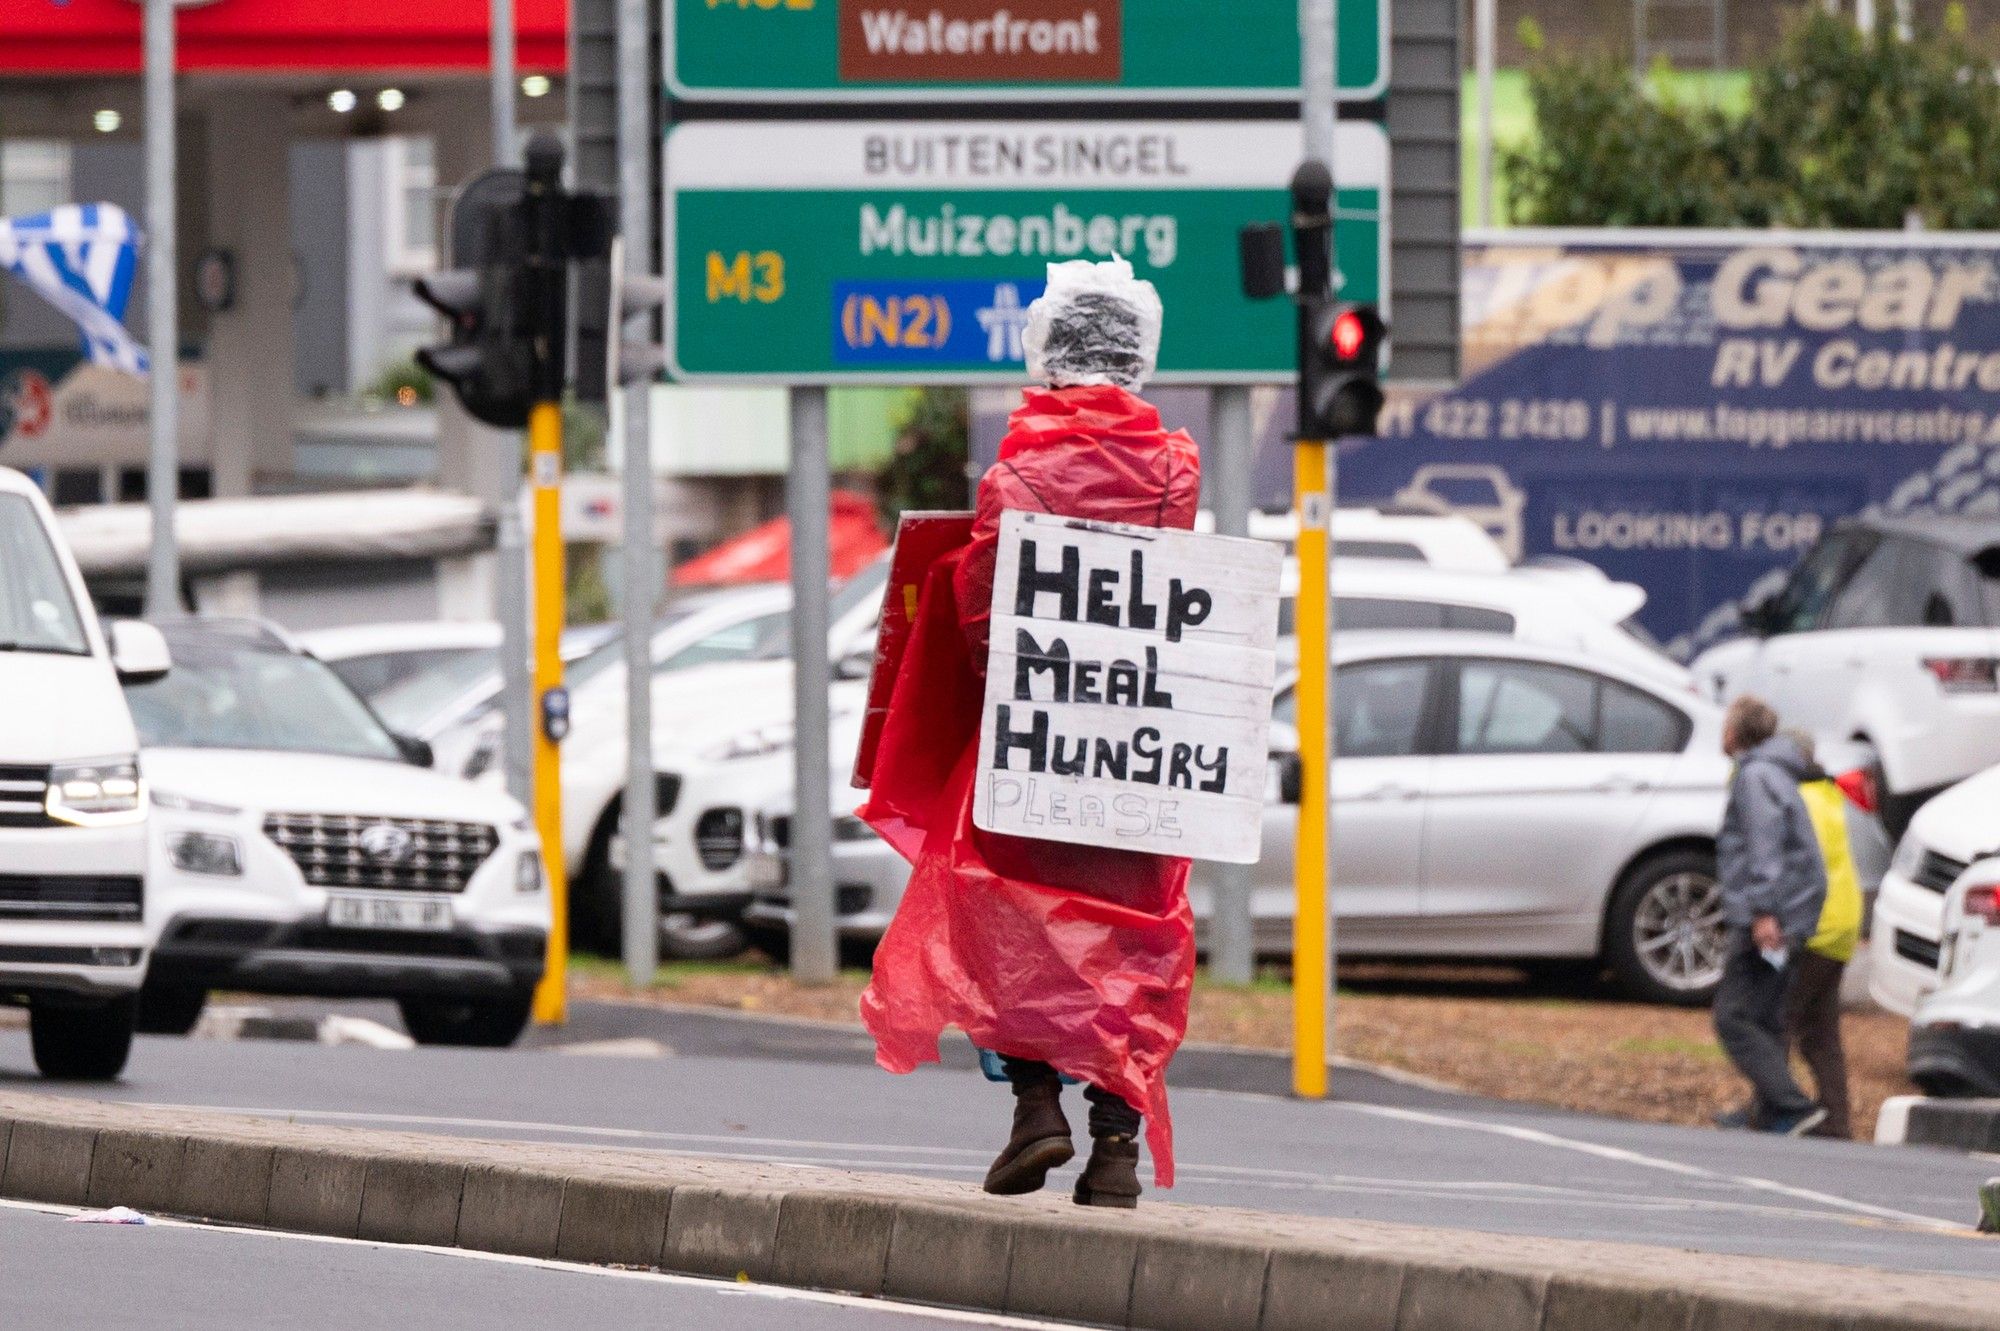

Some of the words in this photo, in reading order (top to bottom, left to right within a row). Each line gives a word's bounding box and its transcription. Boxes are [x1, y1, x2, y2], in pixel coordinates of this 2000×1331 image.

[862, 10, 1101, 56] Waterfront
[859, 201, 1178, 268] Muizenberg
[705, 251, 786, 304] M3
[1711, 246, 1986, 332] Gear
[841, 294, 952, 349] (N2)
[1711, 341, 1801, 389] RV
[1813, 340, 2000, 390] Centre
[1424, 400, 1490, 439] 422
[1499, 400, 1590, 440] 2420
[1554, 512, 1731, 550] LOOKING
[1740, 512, 1823, 550] FOR
[1014, 627, 1173, 709] MEAL
[993, 704, 1229, 794] HUNGRY
[987, 773, 1182, 839] PLEASE
